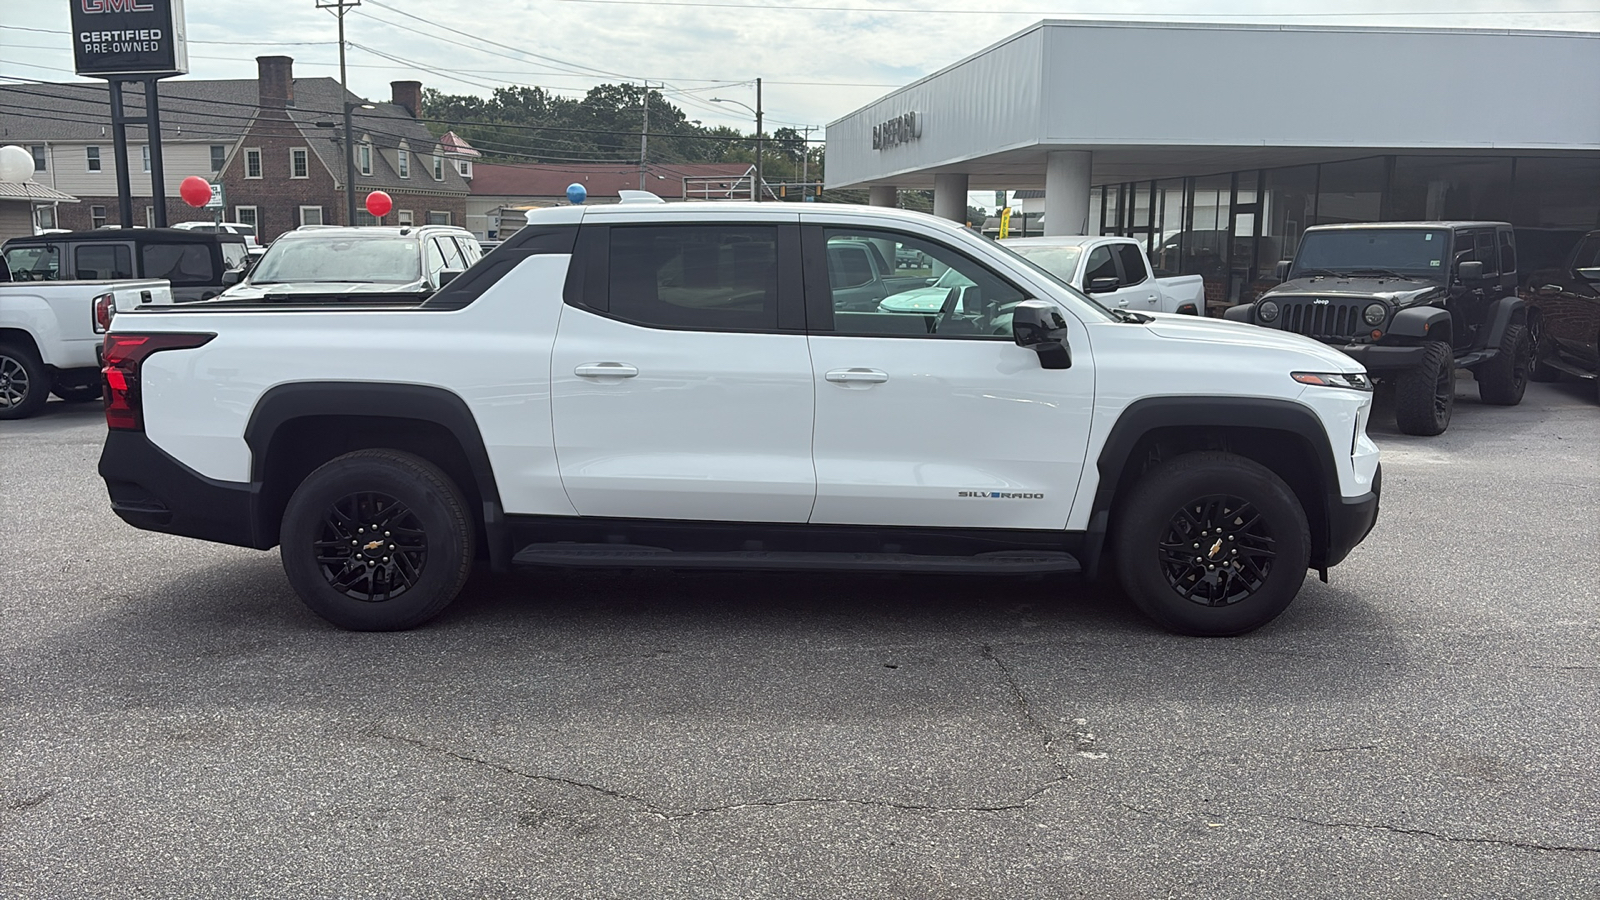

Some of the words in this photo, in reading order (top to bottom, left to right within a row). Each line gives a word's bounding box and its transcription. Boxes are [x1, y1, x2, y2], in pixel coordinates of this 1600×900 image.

[82, 0, 154, 13] GMC
[80, 29, 161, 42] CERTIFIED
[85, 42, 158, 53] PRE-OWNED
[958, 491, 1044, 499] SILVERADO
